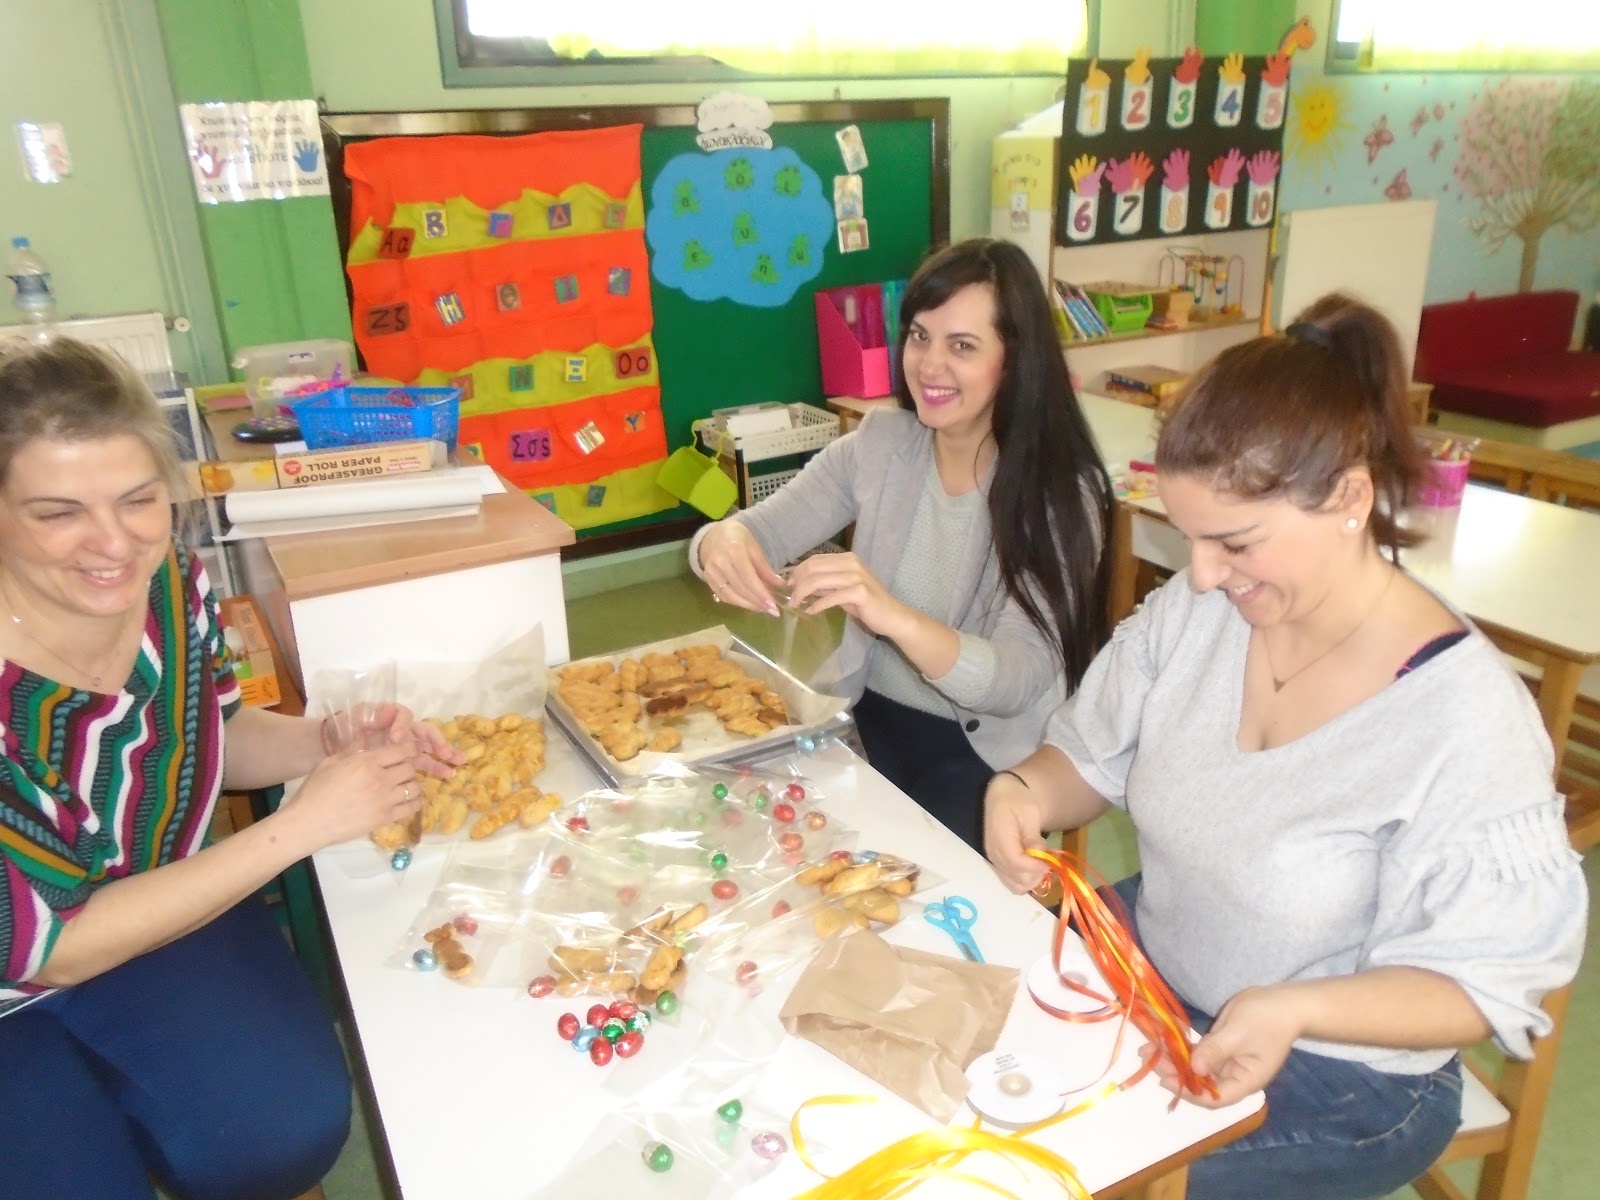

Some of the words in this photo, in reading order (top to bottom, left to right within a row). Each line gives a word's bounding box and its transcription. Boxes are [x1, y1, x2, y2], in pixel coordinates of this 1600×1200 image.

[1085, 94, 1099, 128] 1
[1127, 89, 1147, 124] 2
[1174, 89, 1192, 122] 3
[1221, 89, 1239, 120] 4
[1263, 90, 1282, 124] 5
[1074, 200, 1091, 232] 6
[1120, 195, 1140, 224] 7
[1166, 195, 1183, 228] 8
[1214, 194, 1227, 223] 9
[1252, 191, 1271, 221] 10
[306, 459, 338, 471] ROLL
[341, 455, 381, 467] PAPER
[294, 466, 383, 485] GREASEPROOF
